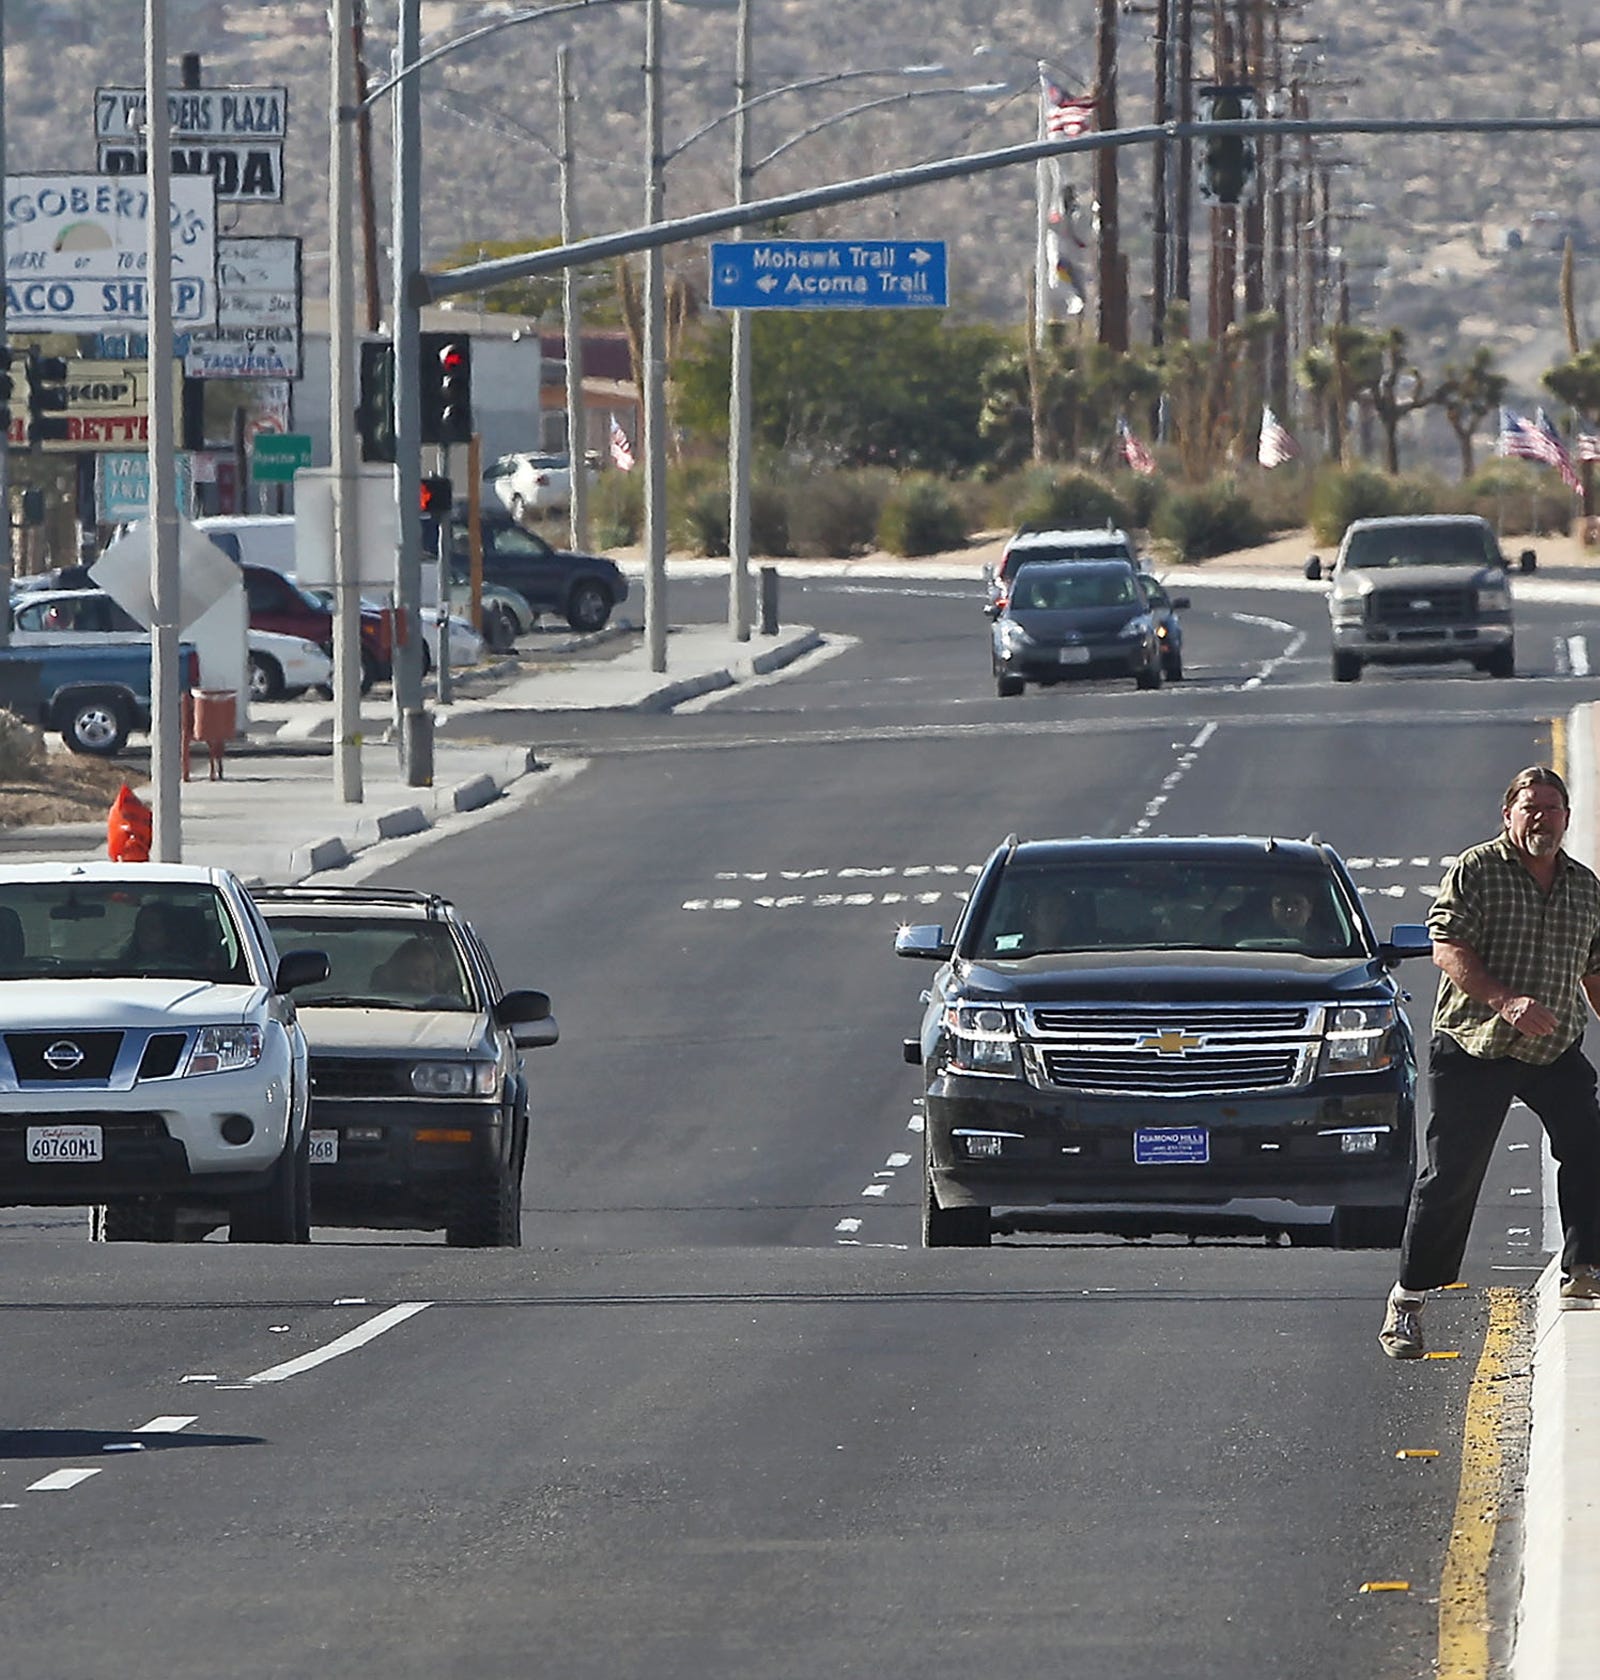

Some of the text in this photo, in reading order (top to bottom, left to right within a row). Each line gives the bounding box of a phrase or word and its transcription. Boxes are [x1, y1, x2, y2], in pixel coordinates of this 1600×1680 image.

[101, 94, 280, 131] 7 WDERS PLAZA
[753, 247, 895, 267] Mohawk Trail
[784, 272, 928, 293] Acoma Trail
[102, 284, 195, 313] SHP
[32, 1139, 98, 1157] 60760M1
